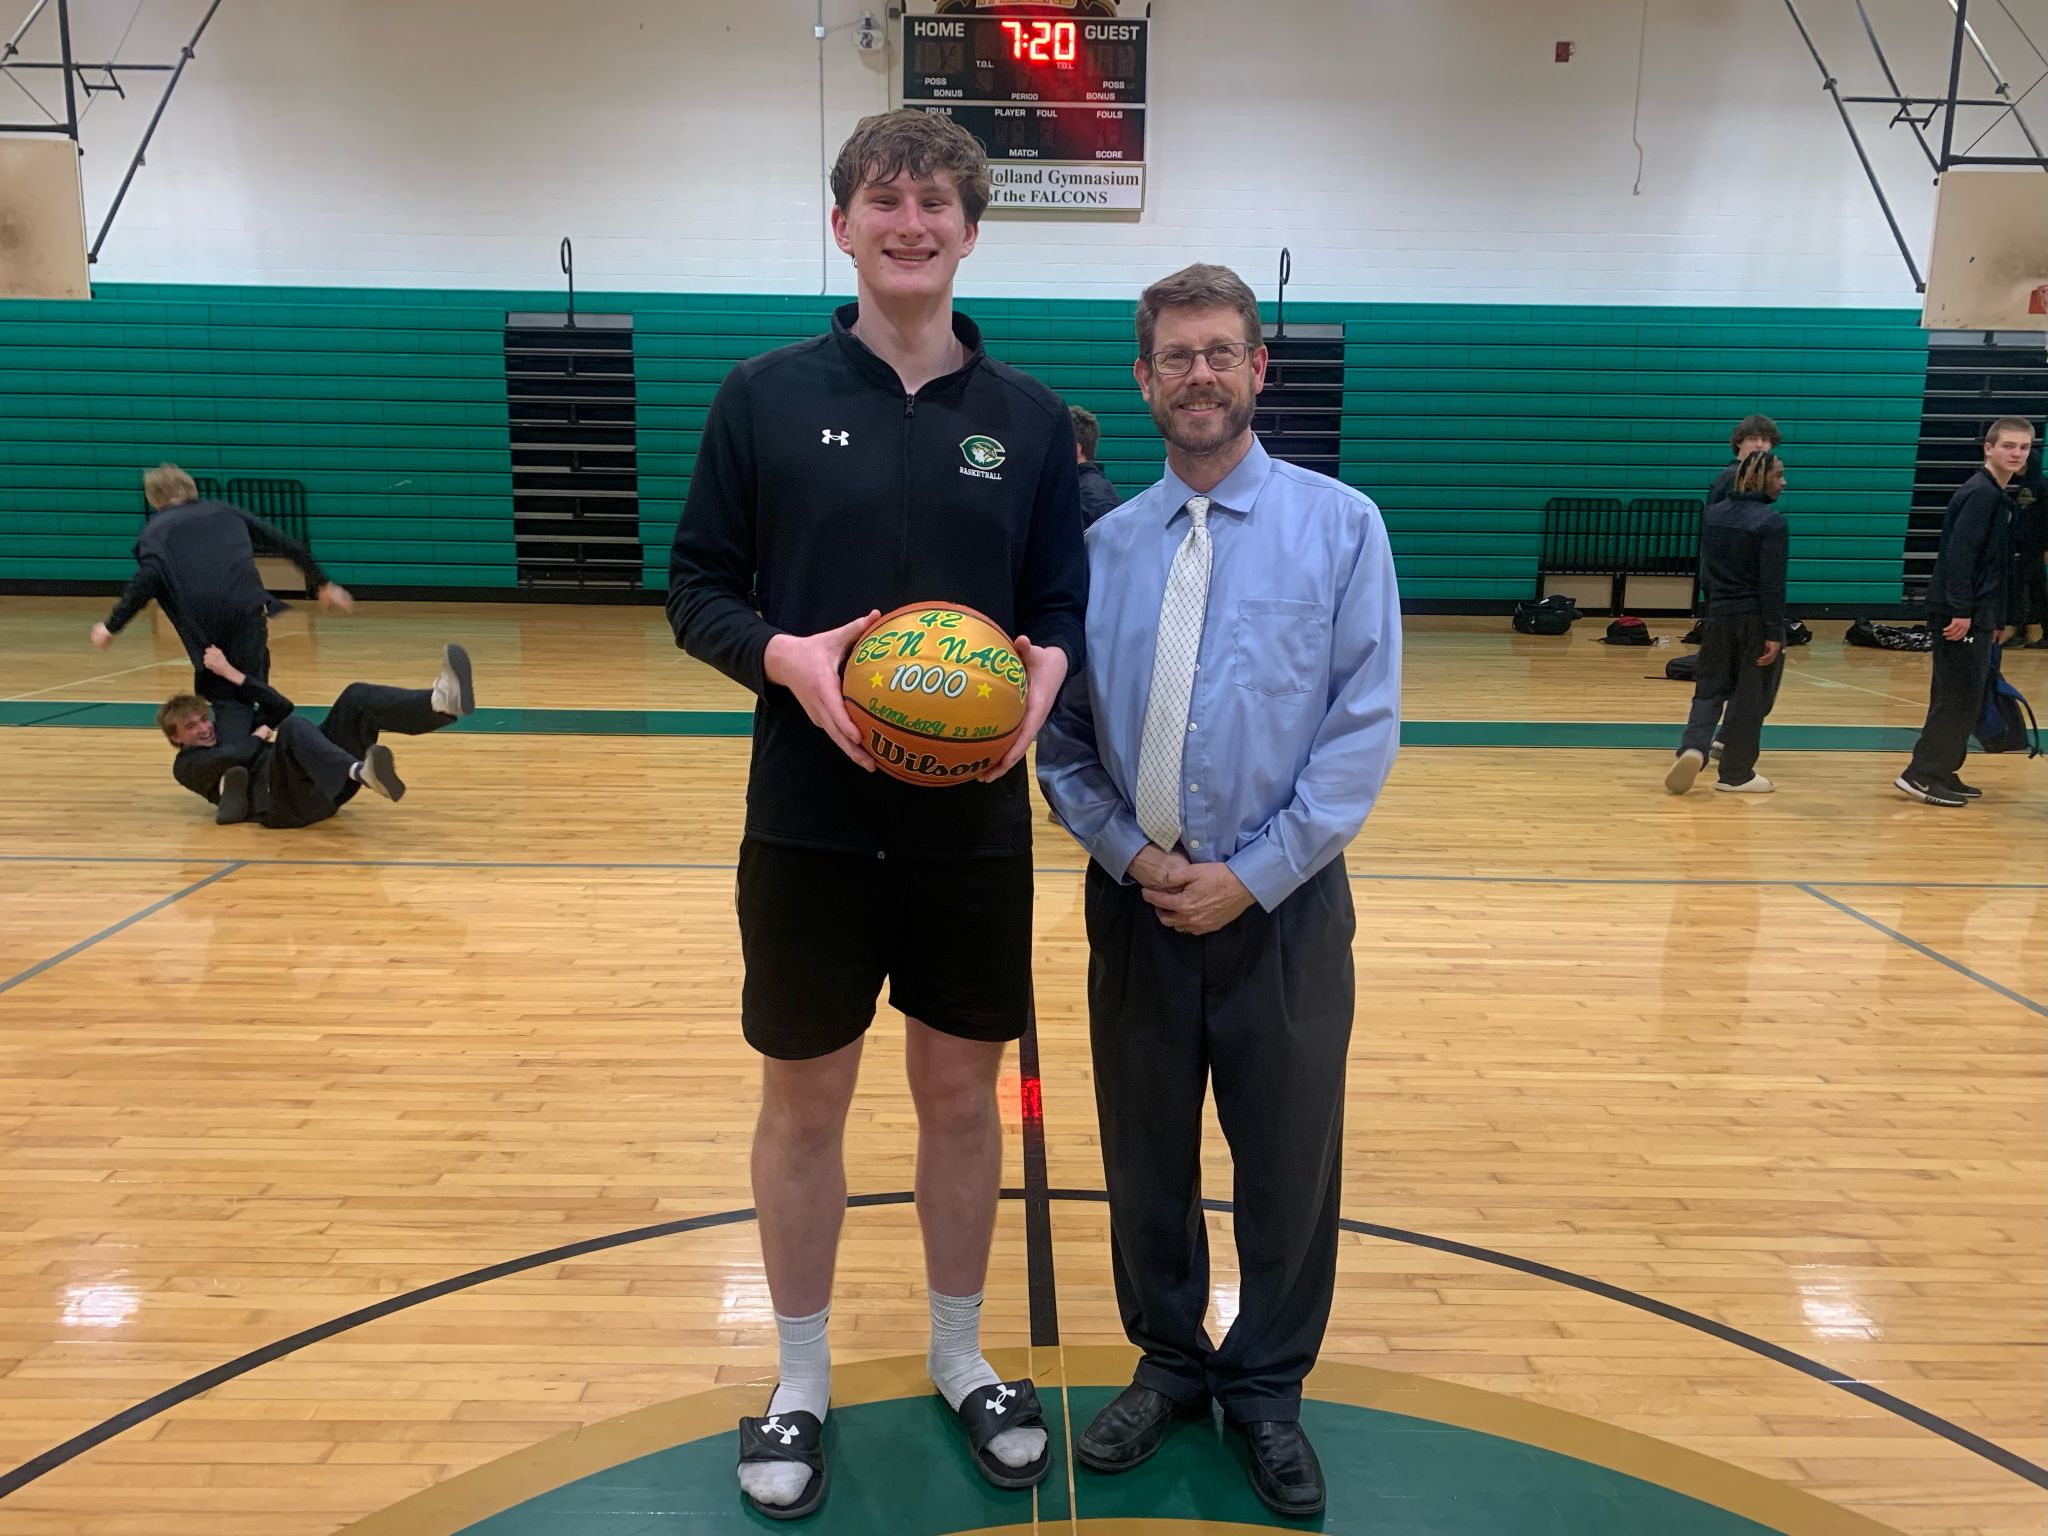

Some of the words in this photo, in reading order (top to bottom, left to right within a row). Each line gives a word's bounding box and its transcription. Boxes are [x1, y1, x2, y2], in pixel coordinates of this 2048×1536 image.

[914, 22, 965, 37] HOME
[1085, 25, 1139, 40] GUEST
[1001, 21, 1076, 60] 7:20
[1103, 81, 1125, 89] POSS
[934, 89, 963, 97] BONUS
[1086, 92, 1115, 100] BONUS
[926, 107, 952, 115] FOULS
[1009, 149, 1039, 157] MATCH
[1048, 169, 1139, 187] Gymnasium
[1003, 190, 1026, 202] the
[1030, 191, 1108, 204] FALCONS
[959, 466, 1002, 480] BASKETBALL
[918, 610, 965, 629] 42
[855, 630, 927, 665] BEN
[889, 663, 968, 698] 1000
[868, 697, 947, 736] JANUARY
[953, 726, 968, 737] 23
[870, 727, 991, 777] Wilson
